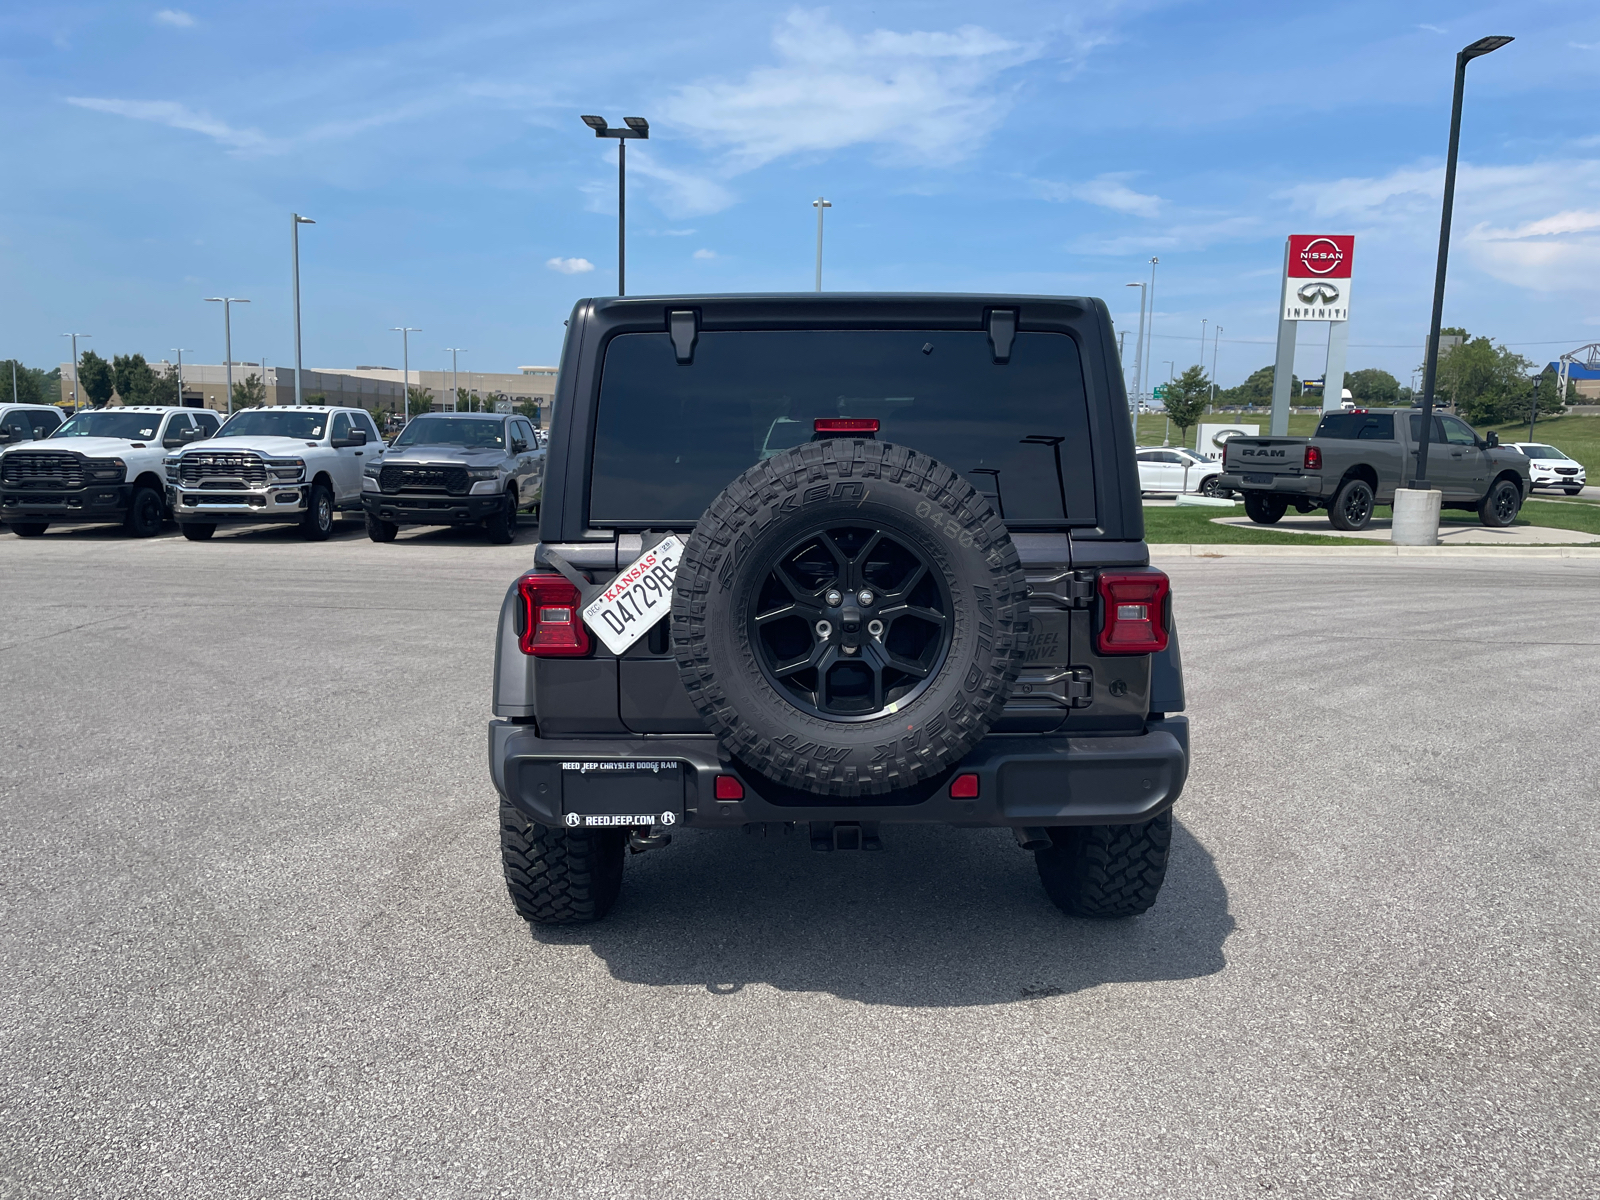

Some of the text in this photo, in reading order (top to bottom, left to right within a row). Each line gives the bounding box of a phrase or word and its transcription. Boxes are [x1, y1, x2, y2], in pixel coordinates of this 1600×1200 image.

[1300, 252, 1344, 260] NISSAN
[1287, 307, 1347, 319] INFINITI
[1242, 449, 1286, 458] RAM
[200, 458, 242, 466] RAM
[718, 482, 865, 593] FALKEN
[604, 554, 657, 602] KANSAS
[586, 603, 601, 617] DEC
[1027, 632, 1059, 646] HEEL
[1025, 645, 1059, 661] RIVE
[870, 584, 995, 761] WILDPEAK
[772, 732, 853, 763] M/T
[562, 761, 678, 770] REED JEEP CHRYSLER DODGE RAM
[585, 815, 655, 826] REEDJEEP.COM
